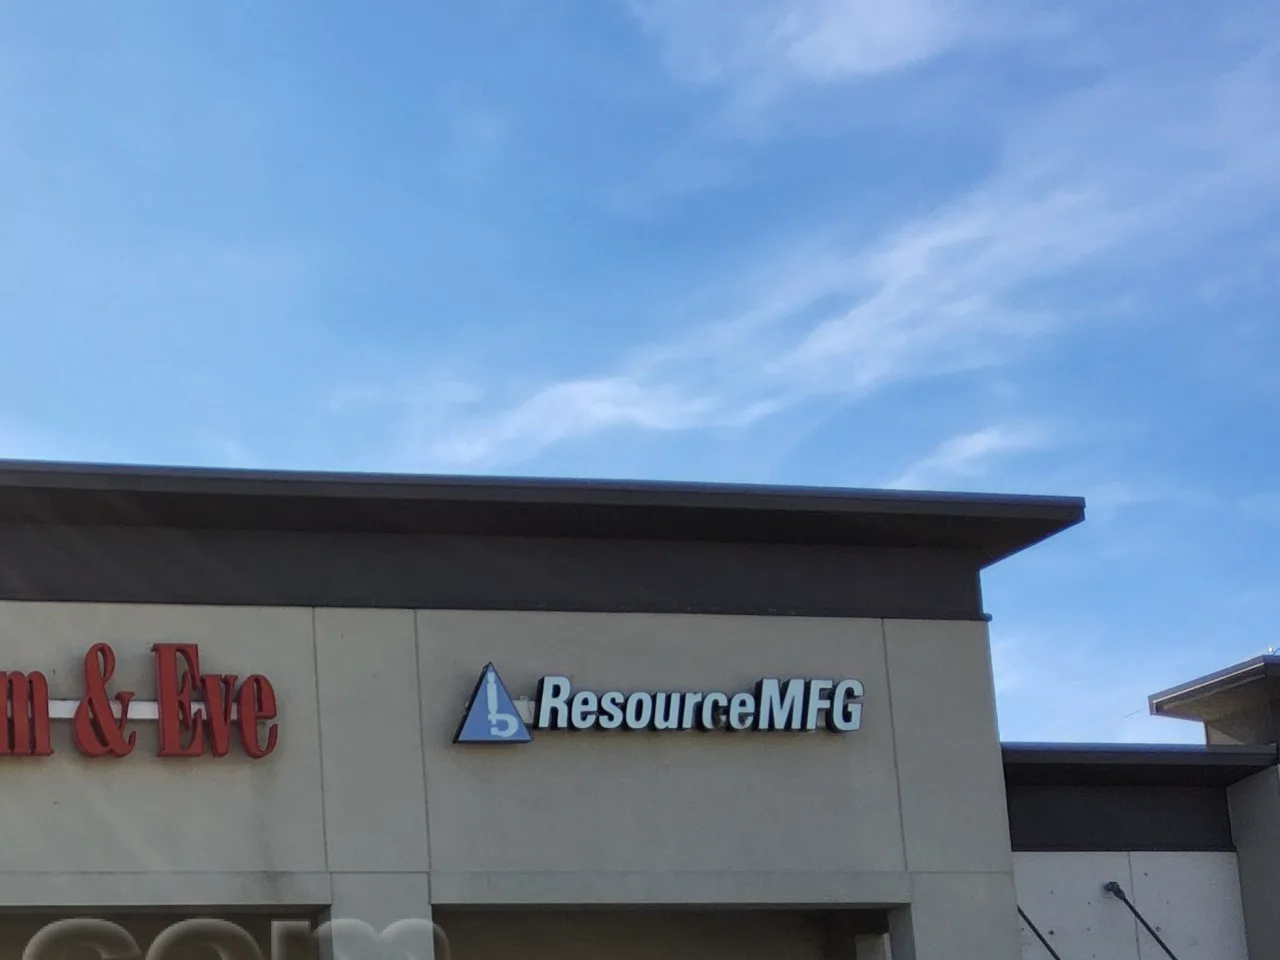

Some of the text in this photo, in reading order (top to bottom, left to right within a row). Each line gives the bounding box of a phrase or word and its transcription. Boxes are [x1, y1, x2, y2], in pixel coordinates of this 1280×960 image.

[74, 642, 136, 758] &
[151, 643, 278, 759] Eve
[536, 675, 864, 733] ResourceMFG
